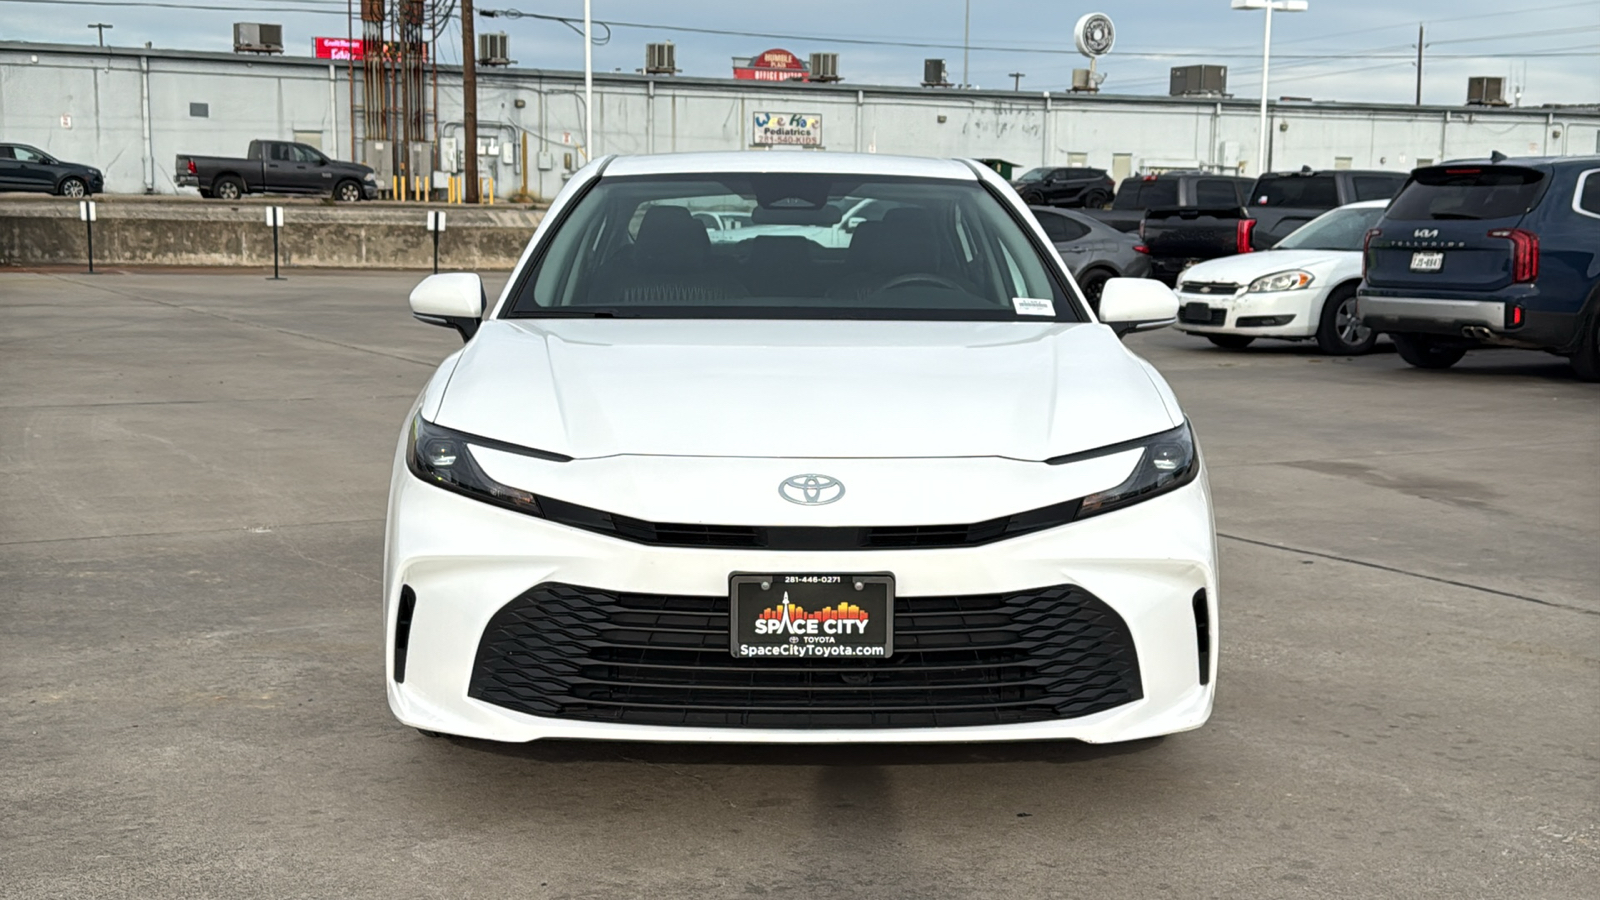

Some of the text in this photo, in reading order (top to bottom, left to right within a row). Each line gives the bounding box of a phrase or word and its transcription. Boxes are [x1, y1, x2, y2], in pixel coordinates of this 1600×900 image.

[764, 53, 793, 63] HUMBLE
[755, 113, 785, 127] Wee
[764, 127, 811, 136] Pediatrics
[754, 618, 869, 634] SPACE CITY
[740, 644, 884, 657] SpaceCityToyota.com
